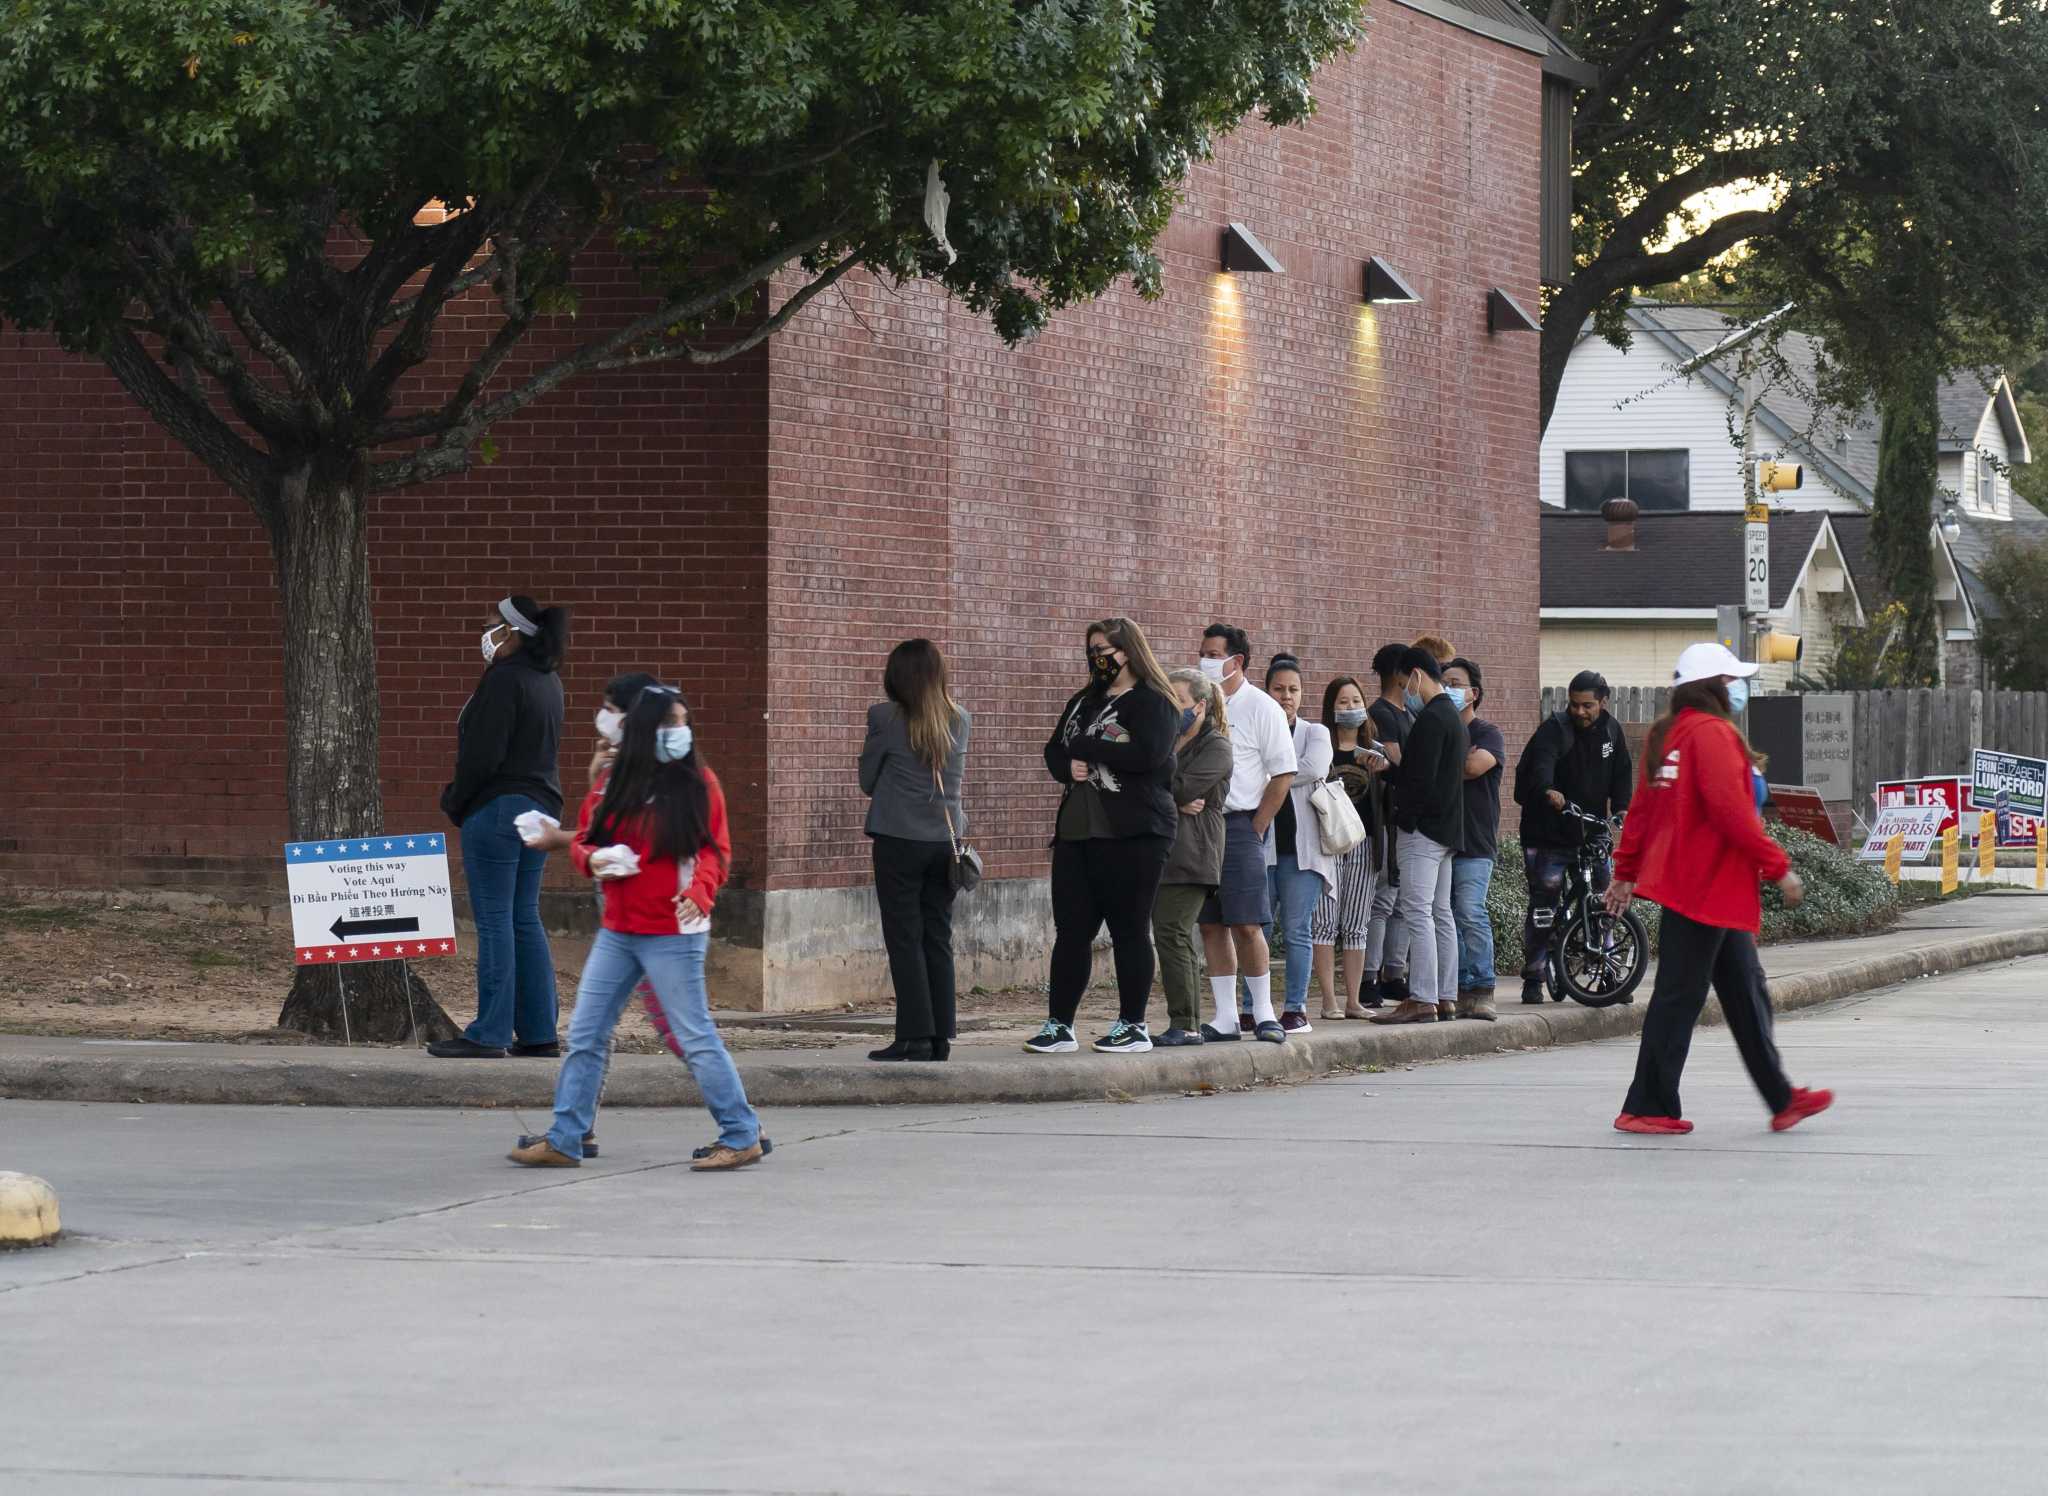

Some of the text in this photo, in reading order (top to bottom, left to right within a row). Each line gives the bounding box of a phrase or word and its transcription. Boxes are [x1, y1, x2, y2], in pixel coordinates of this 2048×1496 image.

[1749, 558, 1766, 582] 20
[1976, 759, 2045, 781] ERIN ELIZABETH
[1975, 771, 2044, 797] LUNCEFORD
[1873, 823, 1934, 836] MORRIS
[1868, 841, 1927, 851] TEXA ENATE
[328, 861, 407, 875] Voting this way
[343, 877, 367, 887] Vote
[361, 889, 387, 900] Theo
[349, 904, 396, 918] 這裡投票
